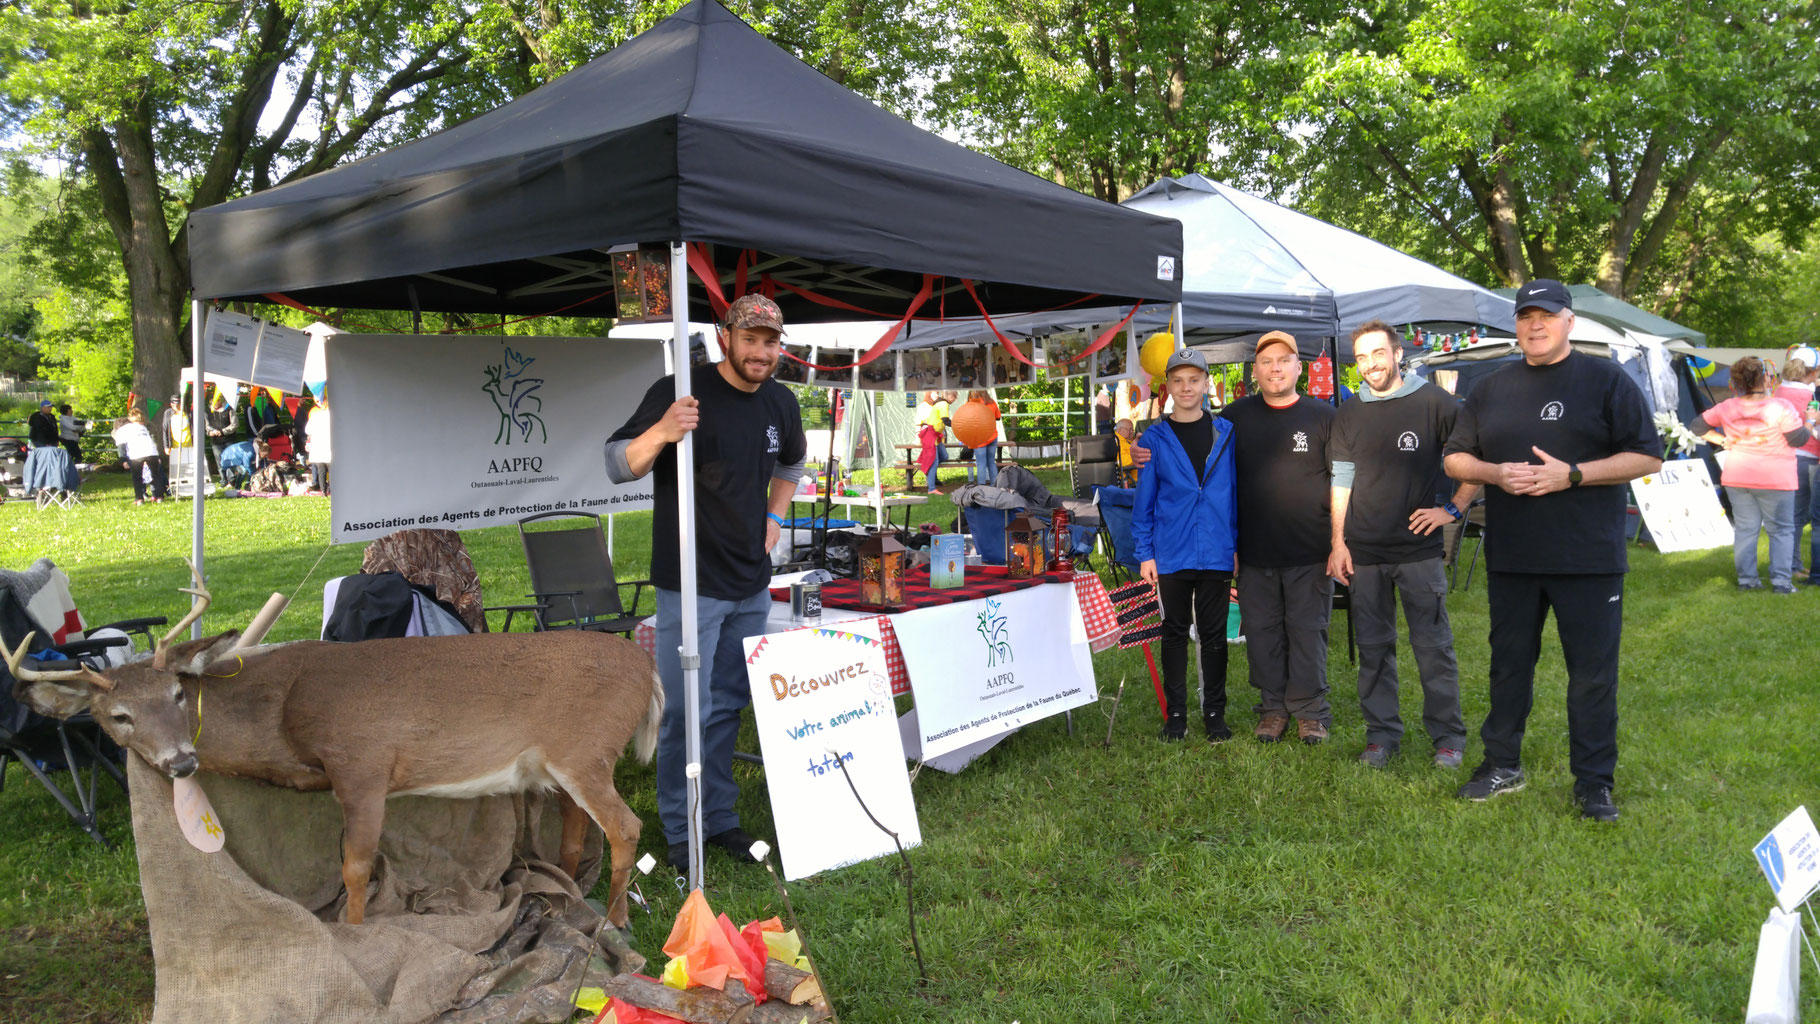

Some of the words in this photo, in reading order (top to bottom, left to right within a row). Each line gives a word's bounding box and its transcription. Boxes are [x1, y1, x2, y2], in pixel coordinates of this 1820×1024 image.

[487, 456, 544, 474] AAPFQ
[1660, 470, 1679, 485] LES
[470, 475, 560, 489] Outaouais-Laval-Laurentides
[343, 515, 416, 532] Association
[418, 511, 440, 524] des
[442, 508, 480, 522] Agents
[483, 507, 496, 518] de
[498, 502, 552, 516] Protection
[554, 500, 566, 510] de
[568, 498, 578, 508] la
[581, 496, 608, 508] Faune
[610, 494, 620, 504] du
[770, 662, 868, 701] Découvrez
[986, 672, 1014, 690] AAPFQ
[830, 700, 872, 728] animal
[926, 726, 960, 743] Association
[960, 723, 970, 732] des
[970, 716, 990, 728] Agents
[990, 713, 998, 721] de
[998, 704, 1026, 718] Protection
[1026, 701, 1033, 709] de
[1038, 696, 1055, 705] Faune
[1062, 687, 1082, 698] Québec
[807, 752, 854, 777] totem
